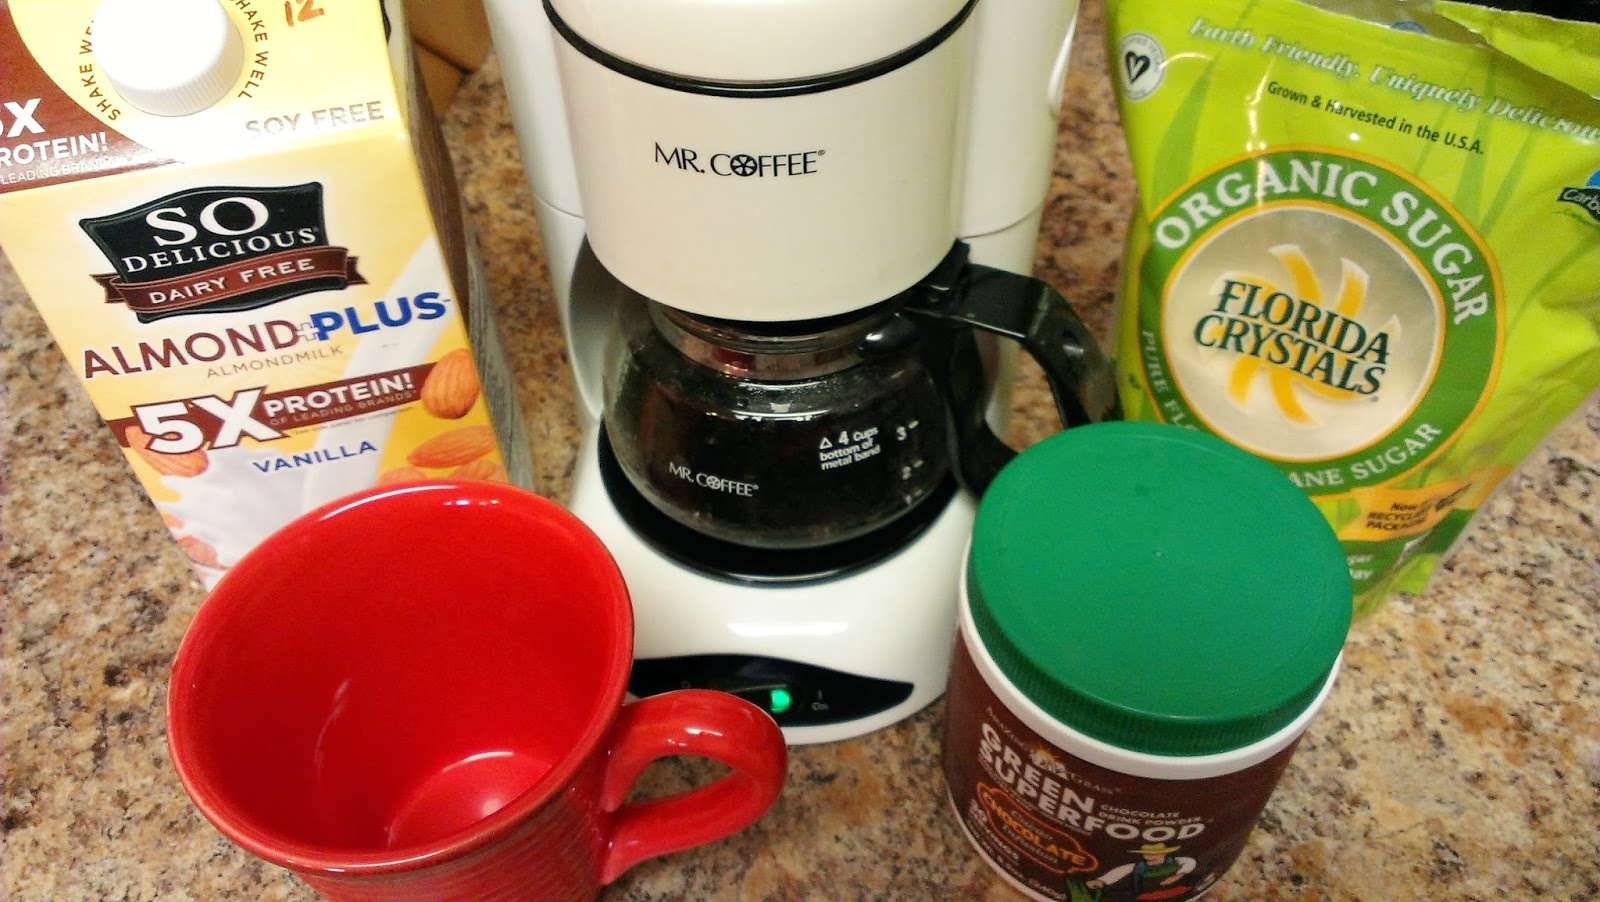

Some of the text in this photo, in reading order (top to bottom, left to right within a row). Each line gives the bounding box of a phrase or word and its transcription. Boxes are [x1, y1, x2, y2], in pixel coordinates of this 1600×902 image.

[229, 0, 269, 98] HAKE WELL
[1189, 18, 1256, 48] Earth
[1368, 64, 1483, 113] Uniquely
[79, 63, 122, 120] SHAKE
[0, 97, 45, 138] X
[245, 100, 385, 136] SOY FREE
[1267, 80, 1484, 154] Grown & Harvested in the U.S.A.
[655, 141, 706, 174] MR.
[145, 196, 270, 247] SO
[1155, 159, 1489, 326] ORGANIC SUGAR
[121, 227, 317, 273] DELICIOUS
[149, 258, 315, 304] DAIRY FREE
[1213, 278, 1391, 365] FLORIDA
[206, 345, 344, 379] ALMONDMILK
[1192, 313, 1387, 396] CRYSTALS
[132, 386, 286, 456] 5X
[262, 372, 414, 418] PROTEIN!
[270, 416, 289, 426] OF
[294, 405, 354, 423] LEADING
[252, 440, 378, 475] VANILLA
[820, 437, 874, 461] bottom of
[821, 444, 881, 471] metal band
[838, 430, 850, 445] 4
[1351, 422, 1442, 481] SUGAR
[669, 461, 695, 483] MR.
[979, 738, 1206, 842] SUPERFOOD
[981, 722, 1095, 814] GREEN
[1100, 803, 1180, 820] CHOCOLATE
